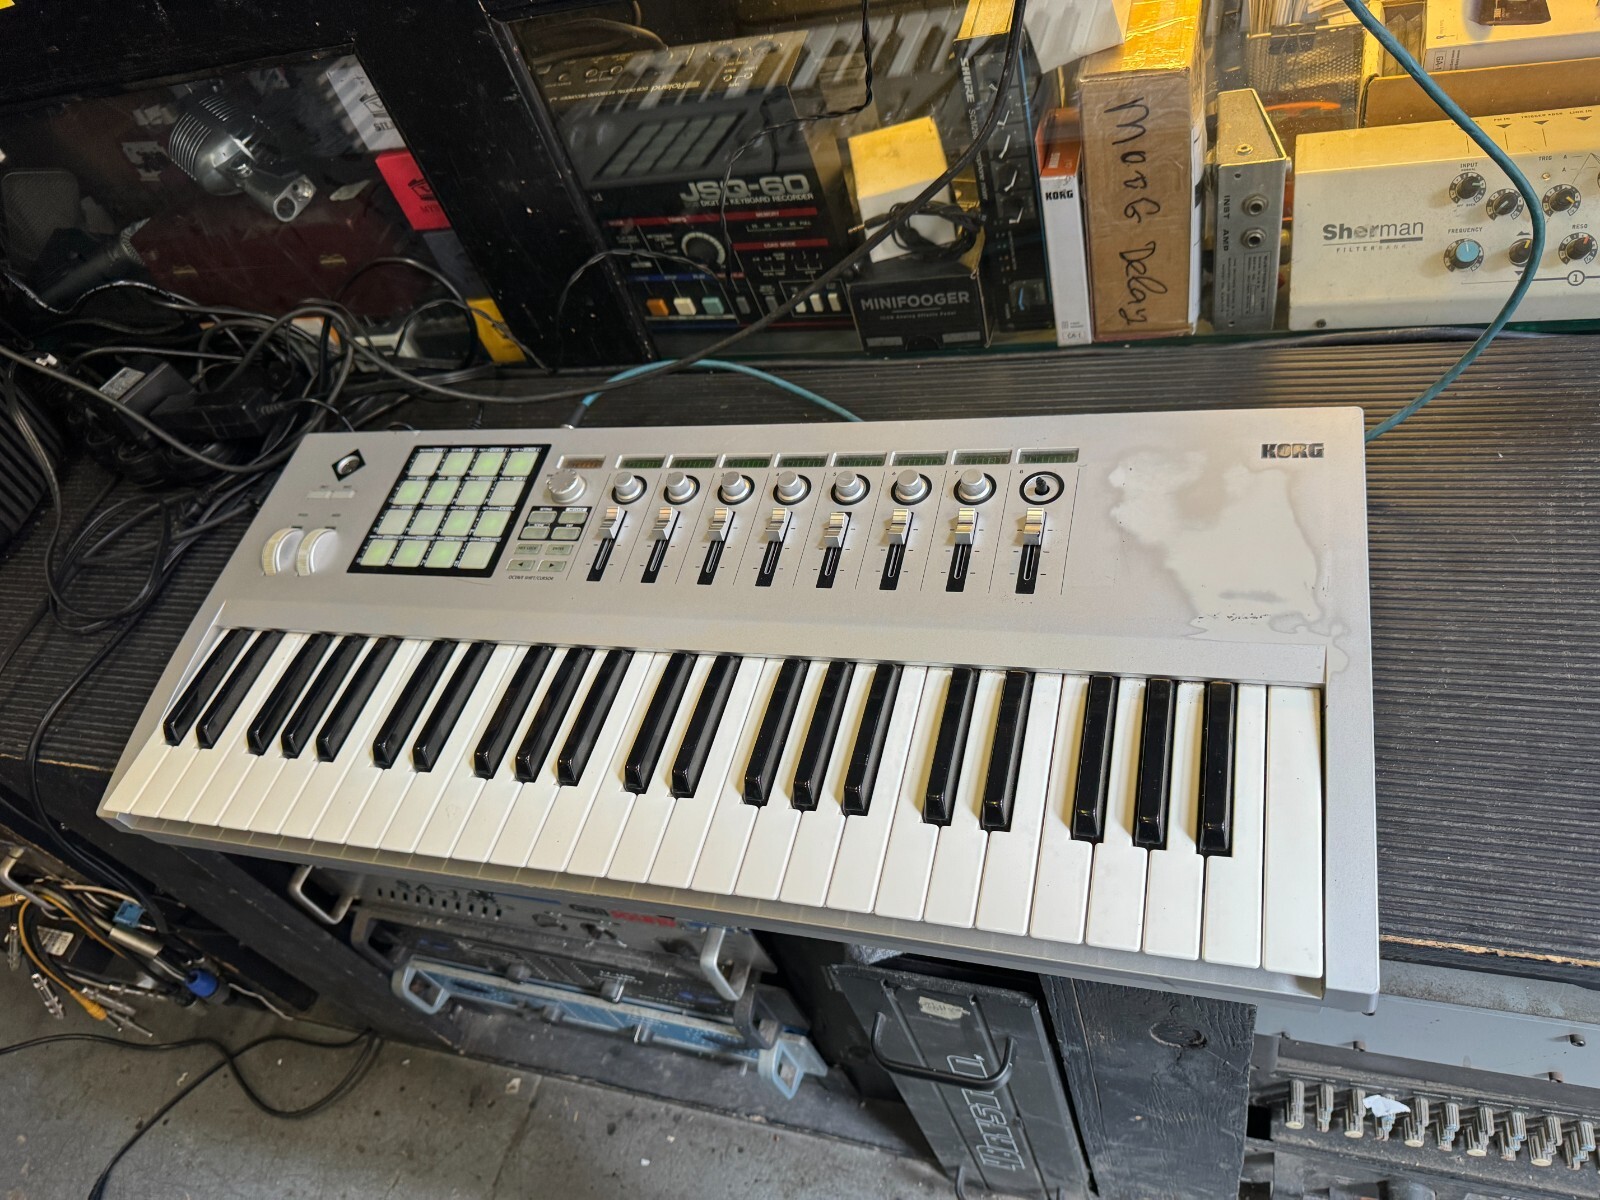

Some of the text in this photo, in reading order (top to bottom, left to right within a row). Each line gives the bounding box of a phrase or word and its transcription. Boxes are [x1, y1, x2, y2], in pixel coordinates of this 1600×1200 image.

[650, 82, 687, 93] Roland
[960, 57, 975, 103] SHURE
[680, 174, 811, 201] JSQ-60
[1045, 190, 1074, 201] KORG
[700, 192, 814, 208] DIGITL KEYBOARD RECORDER
[1223, 195, 1231, 219] INST
[1322, 221, 1424, 241] Sherman
[1447, 226, 1483, 234] FREQUENCY
[1336, 244, 1406, 253] FILTERBANK
[860, 291, 970, 311] MINIFOOGER
[1261, 443, 1324, 459] KORG
